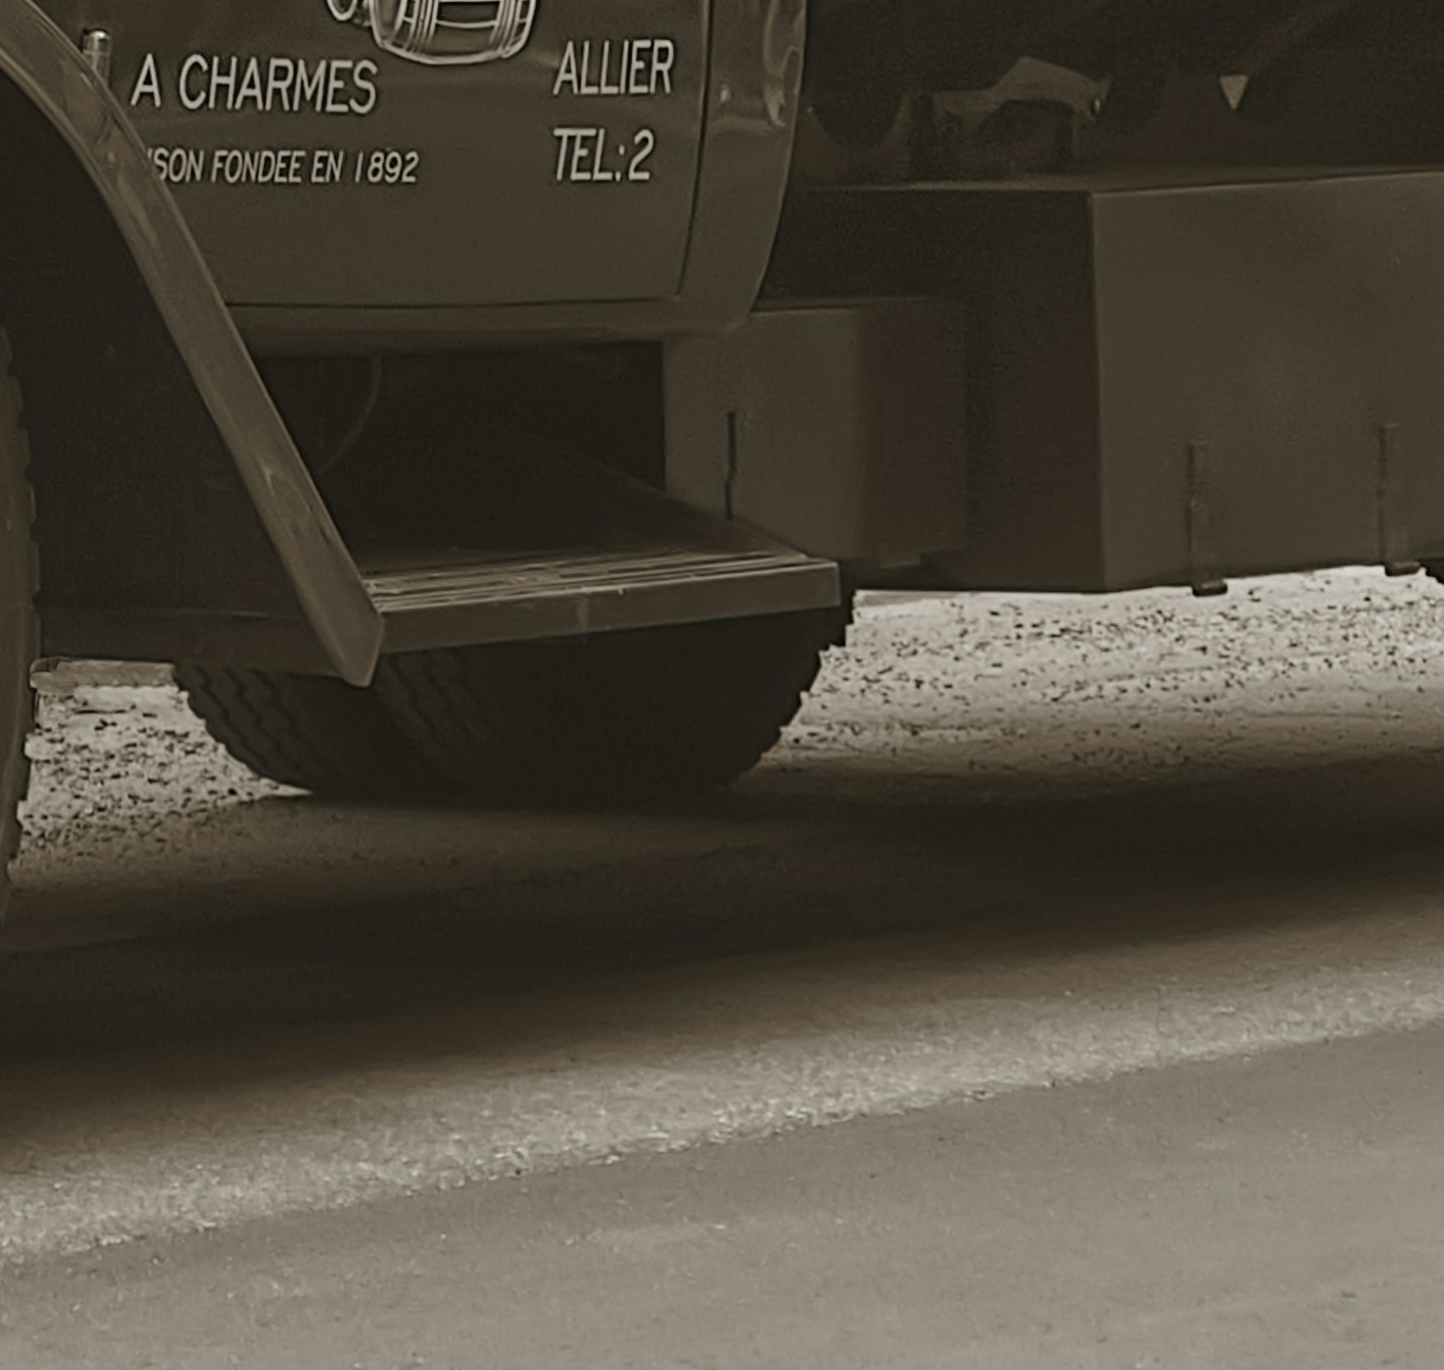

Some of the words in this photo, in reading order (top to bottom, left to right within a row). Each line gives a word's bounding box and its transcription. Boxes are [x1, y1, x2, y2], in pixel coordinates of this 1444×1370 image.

[130, 52, 161, 108] A
[178, 53, 378, 115] CHARMES
[552, 39, 675, 95] ALLIER
[210, 149, 306, 183] FONDEE
[311, 150, 344, 183] EN
[354, 150, 420, 184] 1892
